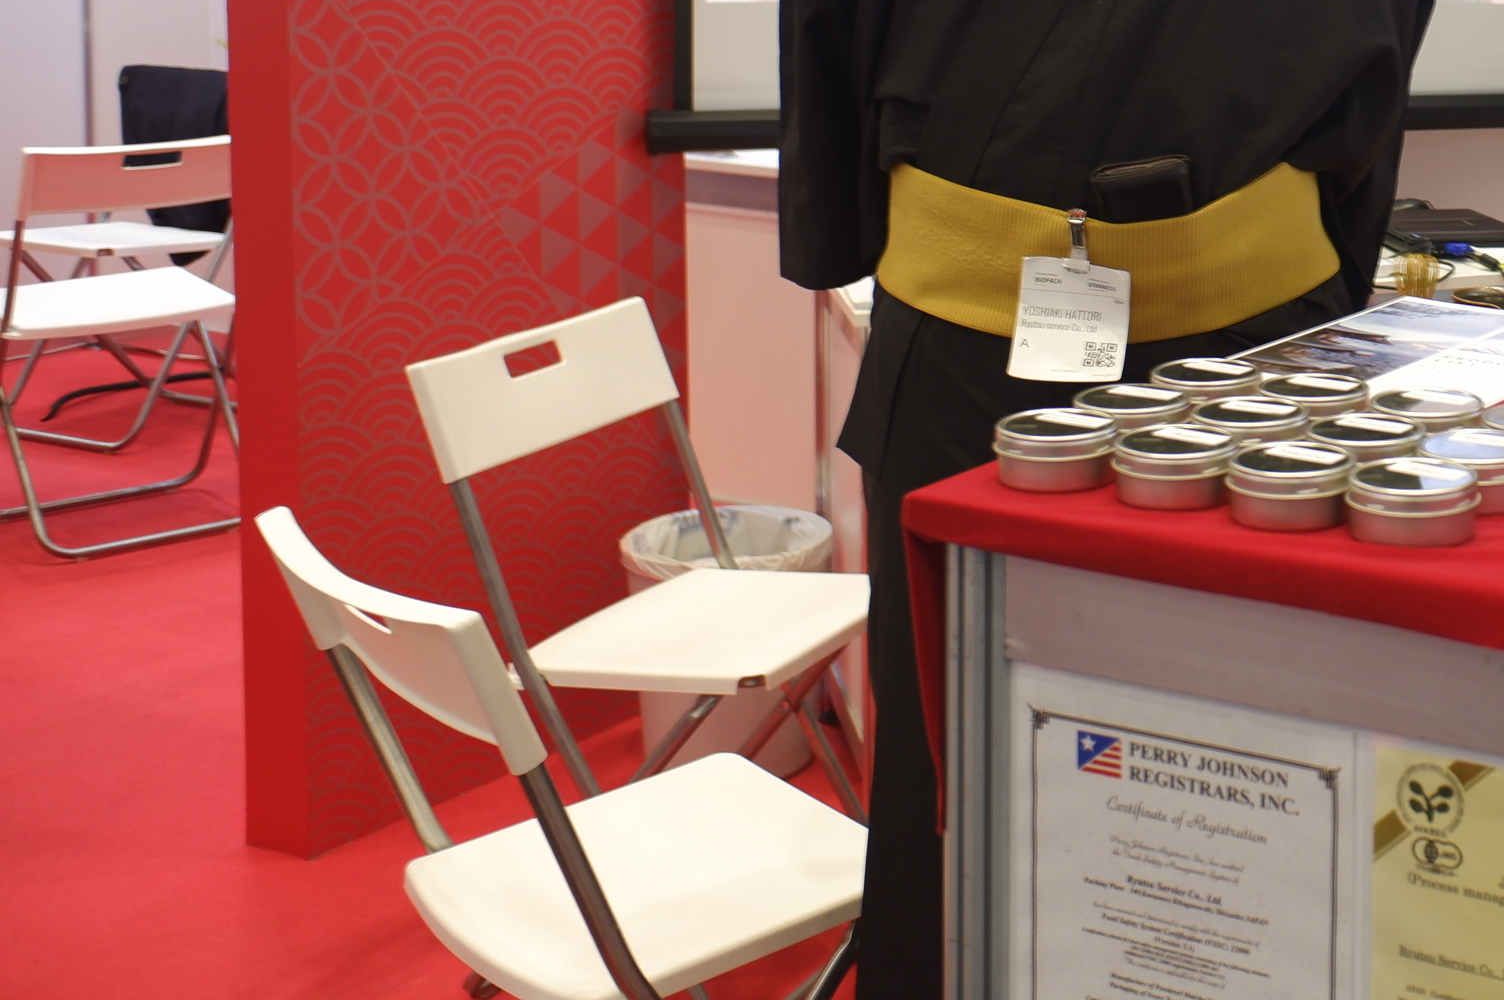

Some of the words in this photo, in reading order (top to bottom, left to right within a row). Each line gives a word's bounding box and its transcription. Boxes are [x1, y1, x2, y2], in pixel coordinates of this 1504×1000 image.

[1020, 318, 1044, 330] Ryutsu
[1086, 324, 1098, 334] Ltd
[1022, 305, 1063, 316] YOSHIAKI
[1065, 308, 1102, 322] HATTORI
[1020, 338, 1029, 348] A
[1129, 741, 1192, 769] PERRY
[1197, 756, 1289, 788] JOHNSON
[1128, 765, 1256, 808] REGISTRARS,
[1259, 791, 1300, 816] INC.
[1106, 795, 1168, 822] Certificate
[1171, 809, 1186, 831] of
[1186, 812, 1268, 844] Registration
